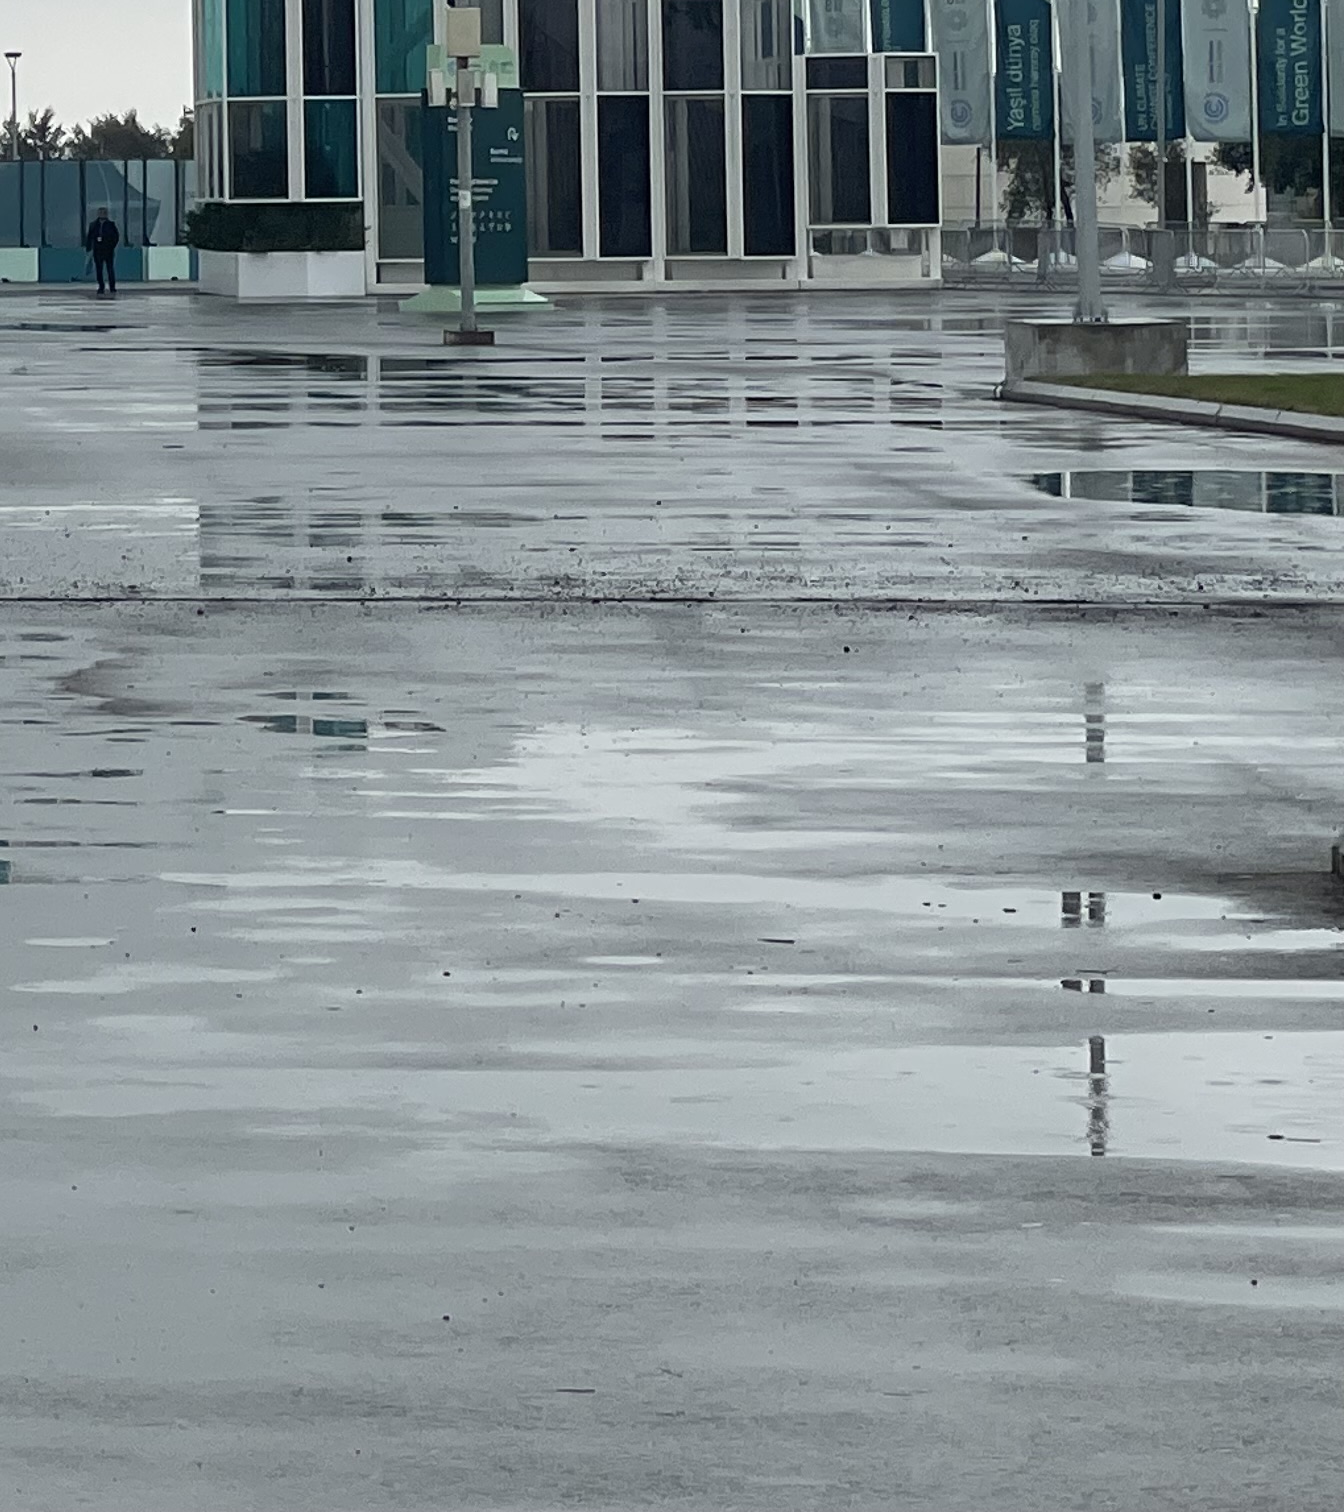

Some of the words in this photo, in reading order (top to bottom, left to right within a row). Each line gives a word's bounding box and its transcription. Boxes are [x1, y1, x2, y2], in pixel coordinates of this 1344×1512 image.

[1006, 24, 1025, 83] dünya
[1007, 87, 1028, 131] Yaşıl
[1291, 60, 1309, 126] Green
